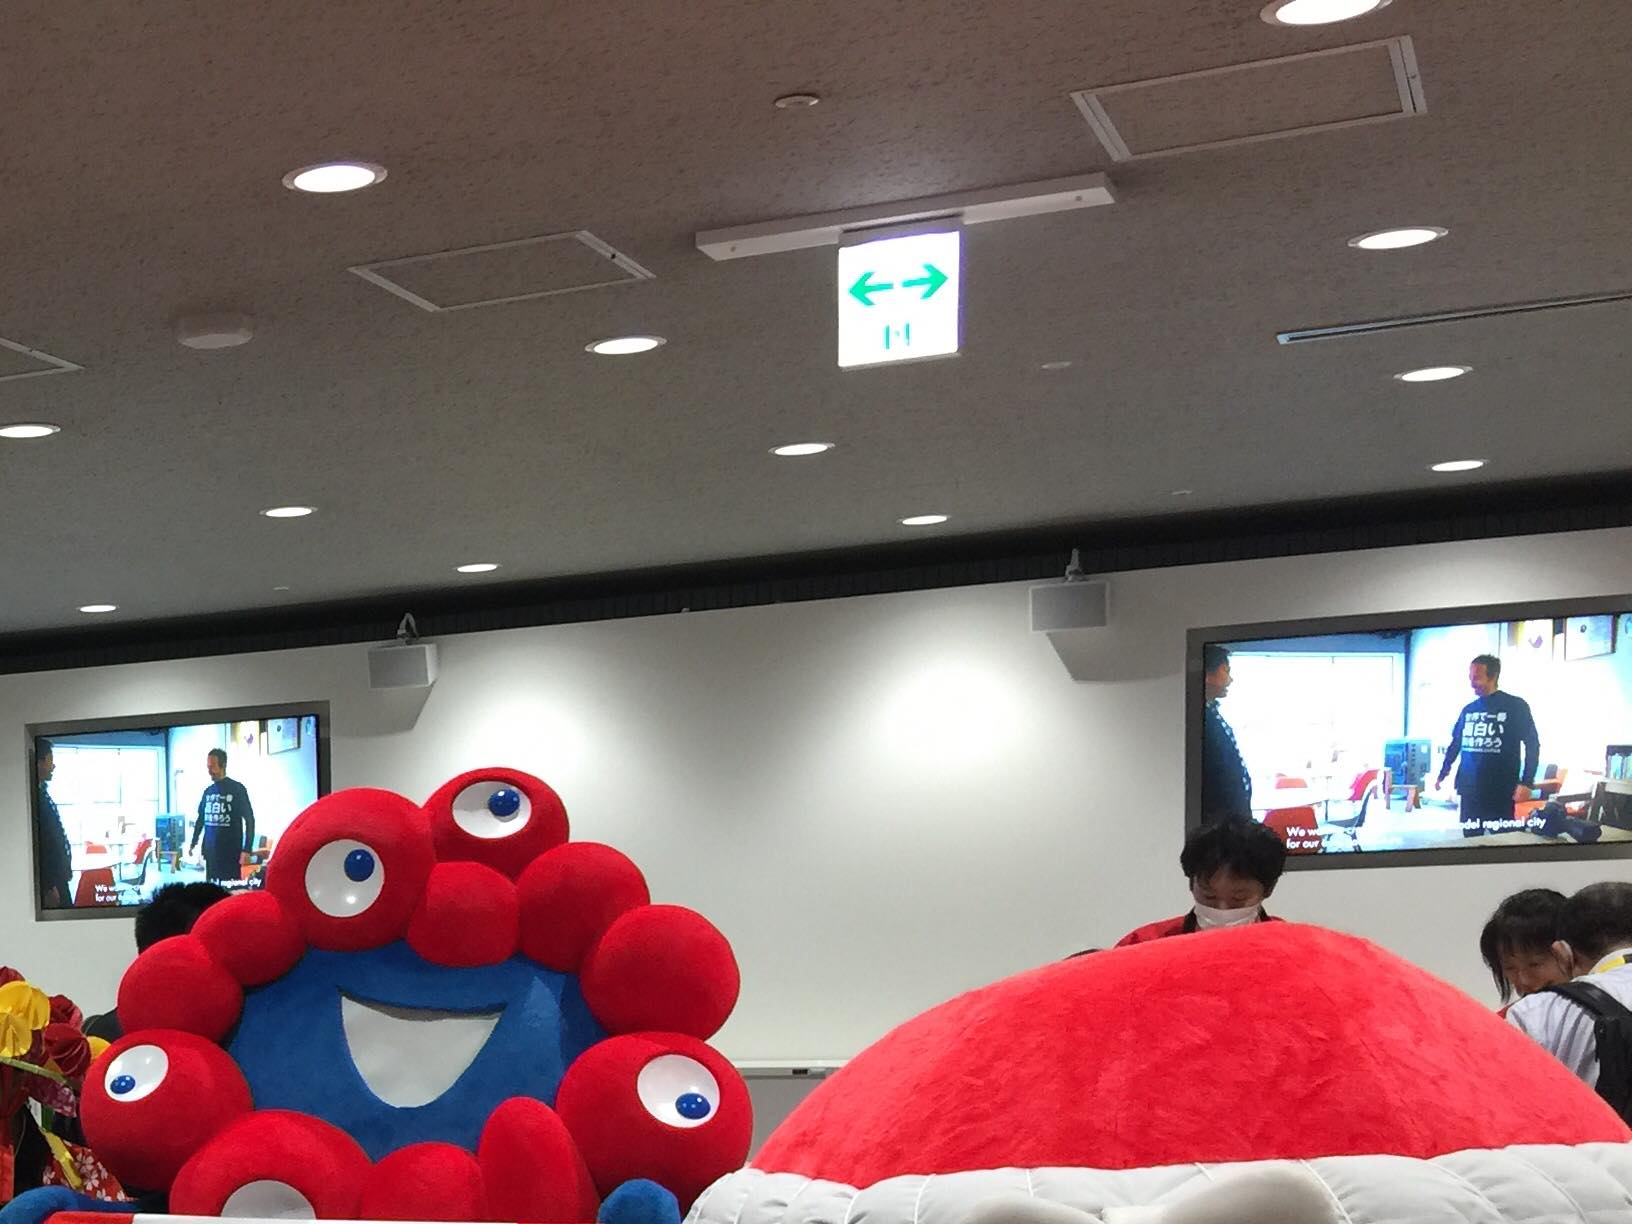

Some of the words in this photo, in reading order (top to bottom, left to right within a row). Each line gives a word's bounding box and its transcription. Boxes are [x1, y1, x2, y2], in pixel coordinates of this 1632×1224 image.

[1482, 816, 1525, 831] regional
[1527, 815, 1547, 829] city
[1286, 826, 1306, 837] We
[1286, 838, 1301, 849] for
[1302, 839, 1319, 849] our
